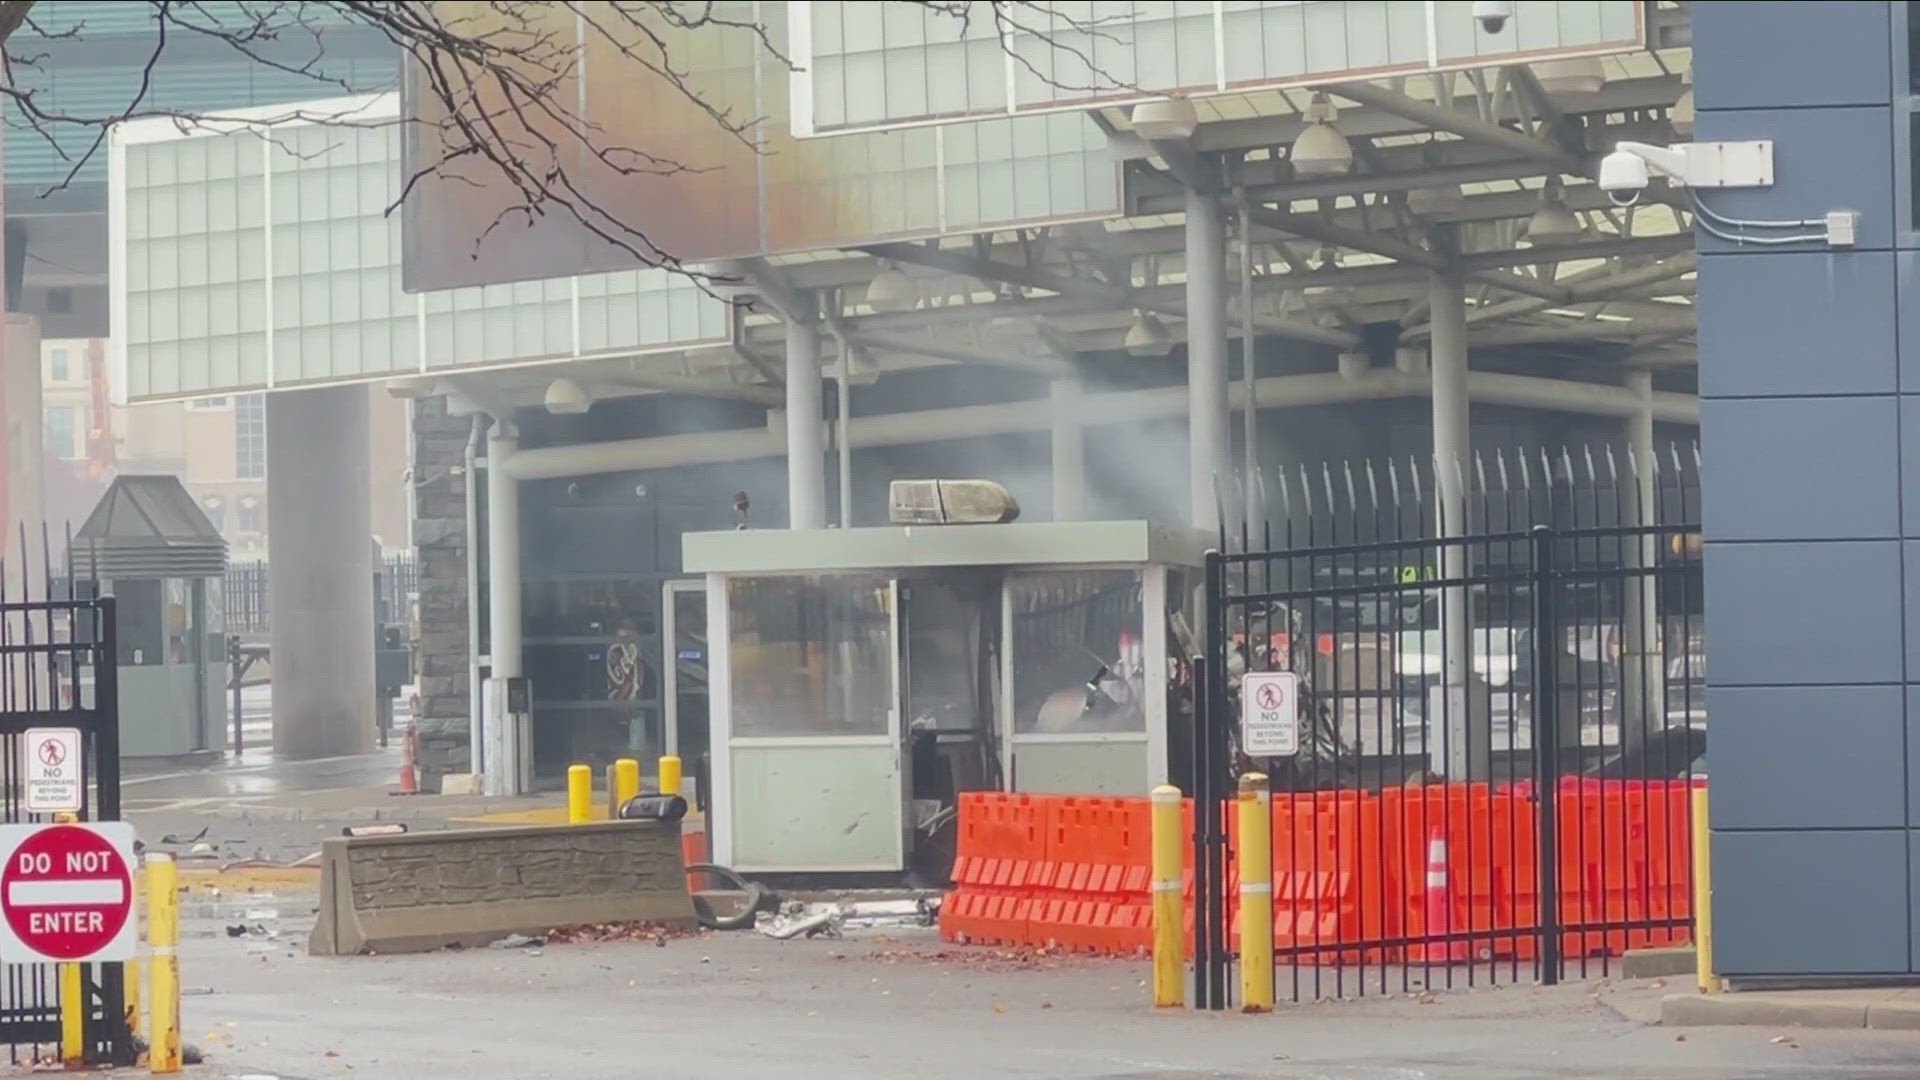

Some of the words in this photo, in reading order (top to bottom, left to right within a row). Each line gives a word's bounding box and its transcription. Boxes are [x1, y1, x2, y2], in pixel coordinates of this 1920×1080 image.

[1261, 711, 1279, 721] NO
[43, 767, 62, 778] NO
[19, 852, 51, 874] DO
[66, 851, 111, 873] NOT
[29, 911, 104, 934] ENTER
